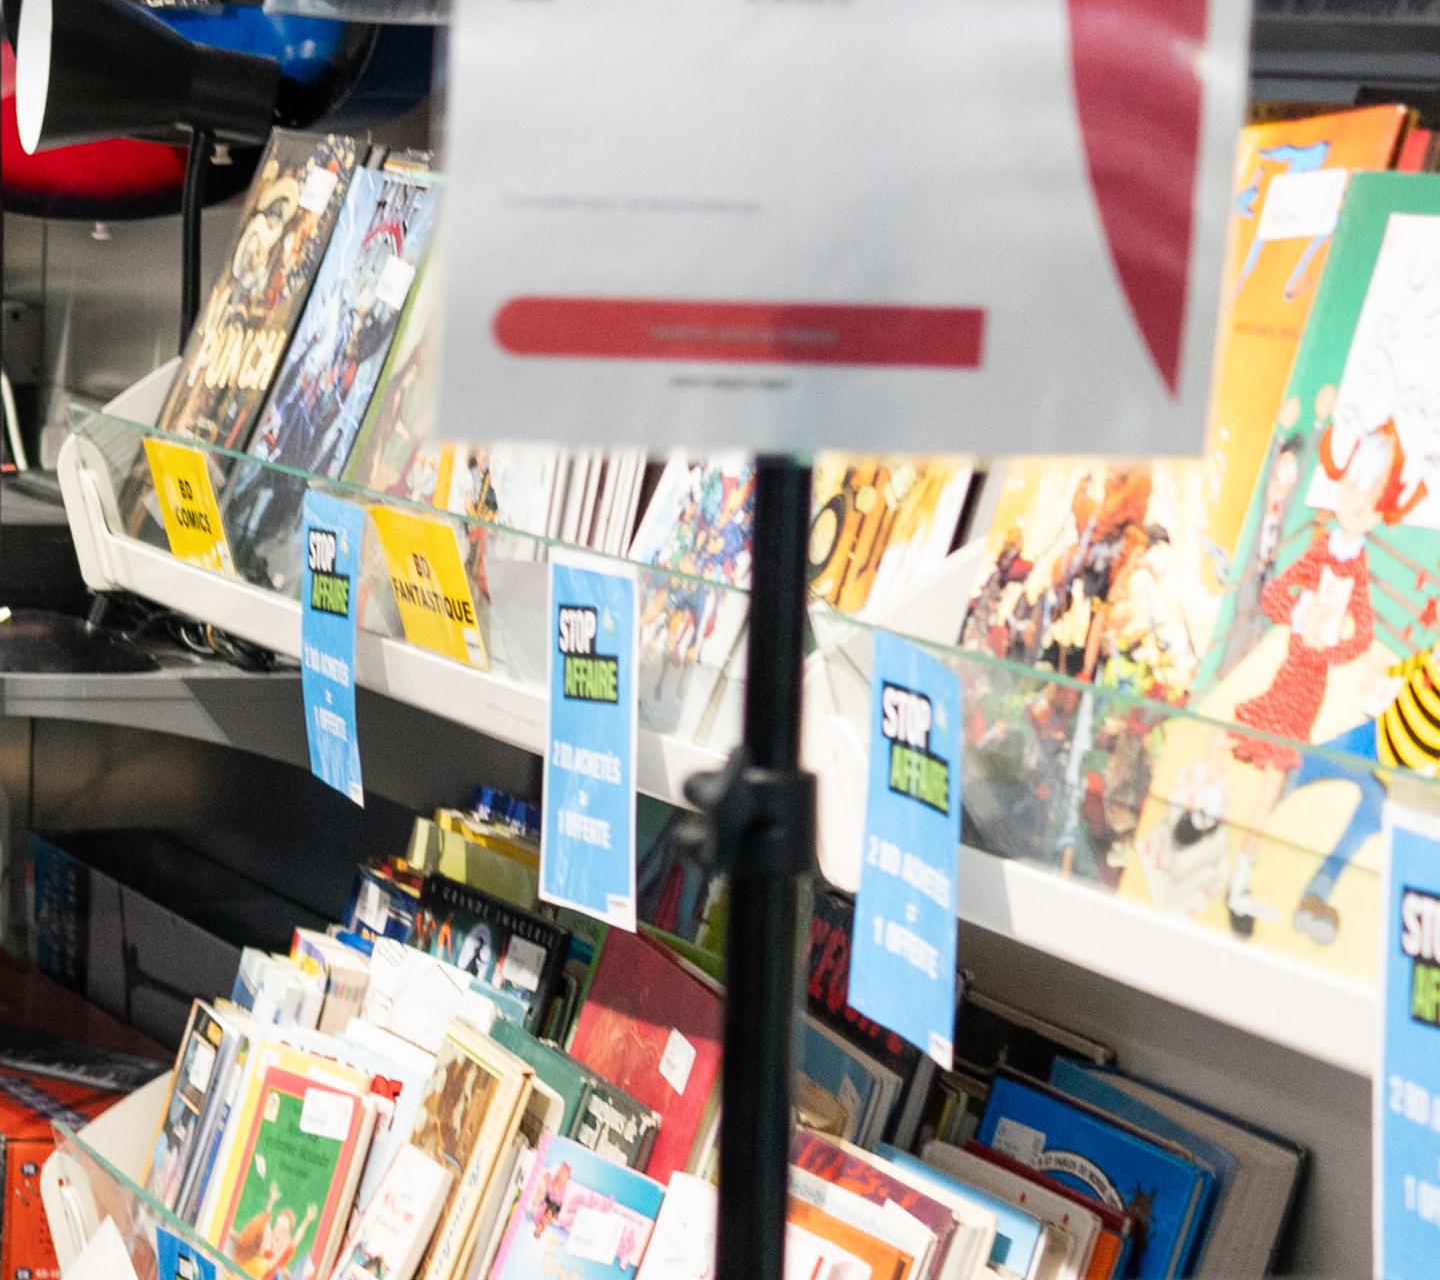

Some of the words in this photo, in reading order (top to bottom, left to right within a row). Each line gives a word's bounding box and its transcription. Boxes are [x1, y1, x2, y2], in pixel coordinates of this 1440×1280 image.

[177, 477, 194, 502] BD
[175, 505, 213, 535] COMICS
[308, 530, 337, 573] STOP
[412, 553, 431, 579] BD
[311, 573, 350, 618] AFFAIRE
[394, 584, 475, 625] FANTASTIQUE
[558, 608, 597, 655] STOP
[564, 655, 618, 703] AFFAIRE
[882, 684, 932, 754] STOP
[890, 743, 950, 812] AFFAIRE
